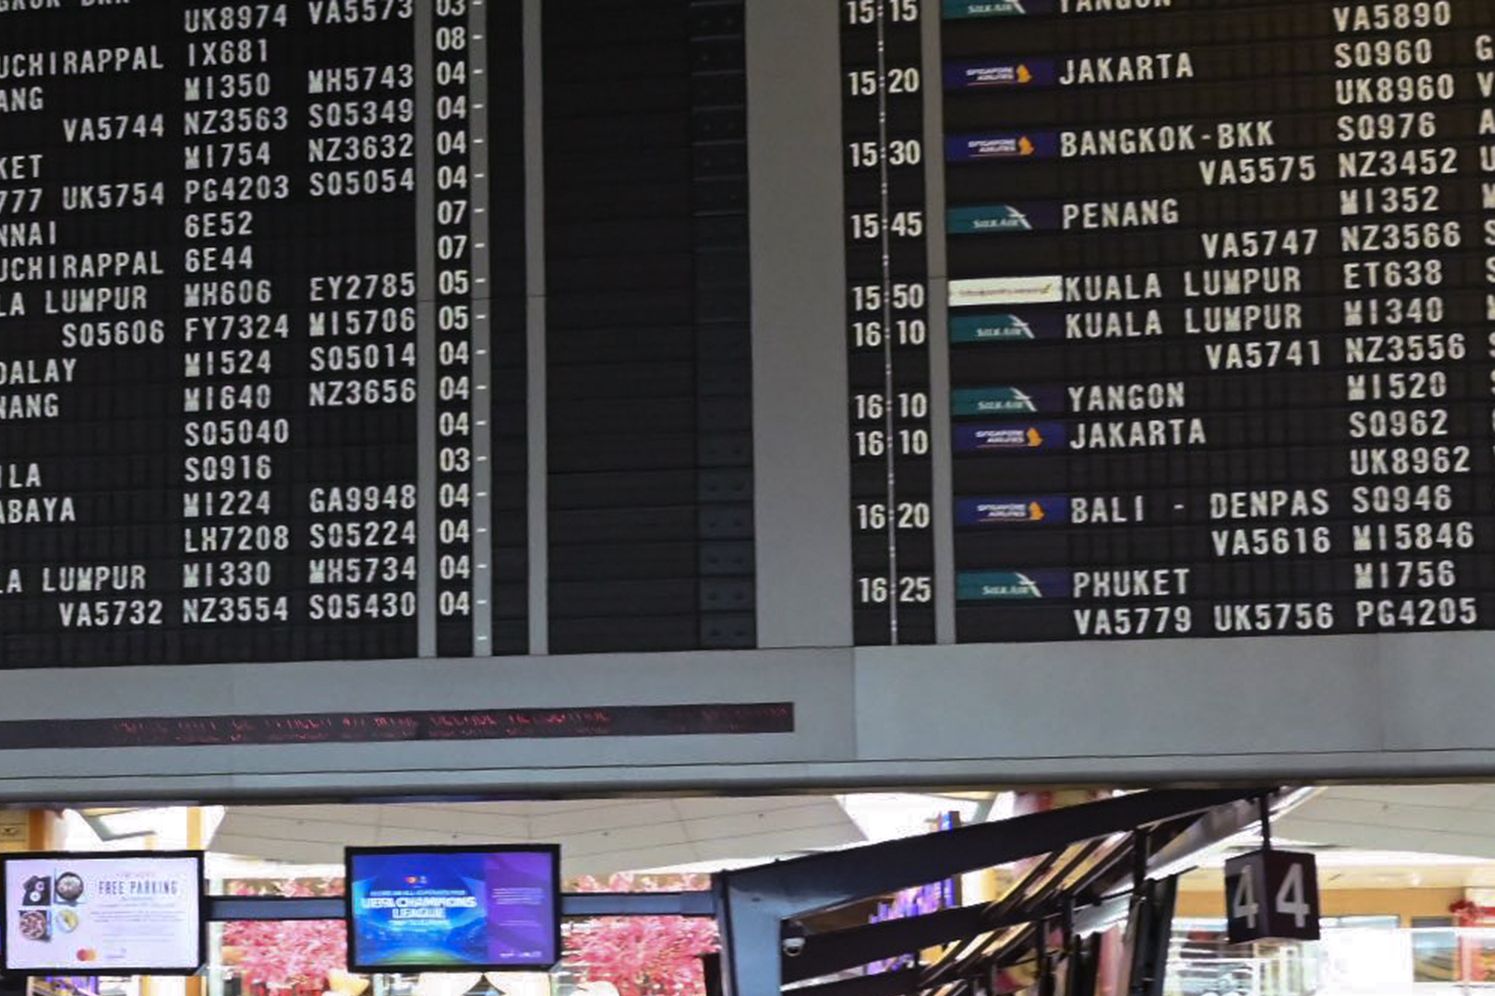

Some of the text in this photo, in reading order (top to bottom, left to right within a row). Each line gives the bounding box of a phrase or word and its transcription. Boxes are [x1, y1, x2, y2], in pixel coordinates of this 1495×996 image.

[185, 4, 286, 33] UK8974
[1333, 0, 1451, 32] VA5890
[1059, 52, 1193, 85] JAKARTA
[1336, 73, 1454, 105] UK8960
[63, 114, 163, 142] VA5744
[185, 106, 287, 135] NZ3563
[309, 133, 413, 162] NZ3632
[1061, 120, 1274, 157] BANGKOK-BKK
[1199, 155, 1315, 186] VA5575
[1339, 147, 1457, 178] NZ3452
[63, 182, 164, 210] UK5754
[185, 175, 289, 203] PG4203
[185, 210, 252, 238] 6E52
[1063, 198, 1178, 229] PENANG
[1201, 228, 1318, 259] VA5747
[1341, 221, 1461, 252] NZ3566
[185, 245, 252, 273] 6E44
[1344, 259, 1442, 289] ET638
[311, 272, 415, 301] EY2785
[1065, 266, 1300, 302] KUALA LUMPUR
[45, 285, 146, 314] LUMPUR
[185, 314, 289, 342] FY7324
[1066, 303, 1301, 339] KUALA LUMPUR
[1205, 340, 1320, 370] VA5741
[1346, 333, 1465, 363] NZ3556
[309, 378, 416, 406] NZ3656
[1068, 382, 1184, 412] YANGON
[1070, 418, 1206, 450] JAKARTA
[1350, 445, 1470, 476] UK8962
[310, 484, 416, 513] GA9948
[1072, 488, 1329, 524] BALI DENPAS
[185, 525, 289, 553] LH7208
[1211, 526, 1331, 556] VA5616
[43, 565, 146, 592] LUMPUR
[1074, 568, 1190, 598] PHUKET
[59, 599, 163, 627] VA5732
[183, 596, 288, 623] NZ3554
[1074, 606, 1191, 635] VA5779
[1214, 602, 1333, 632] UK5756
[1356, 597, 1477, 627] PG4205
[98, 879, 178, 895] FREE PARKING
[1232, 864, 1259, 930] 4
[1275, 862, 1311, 929] 4
